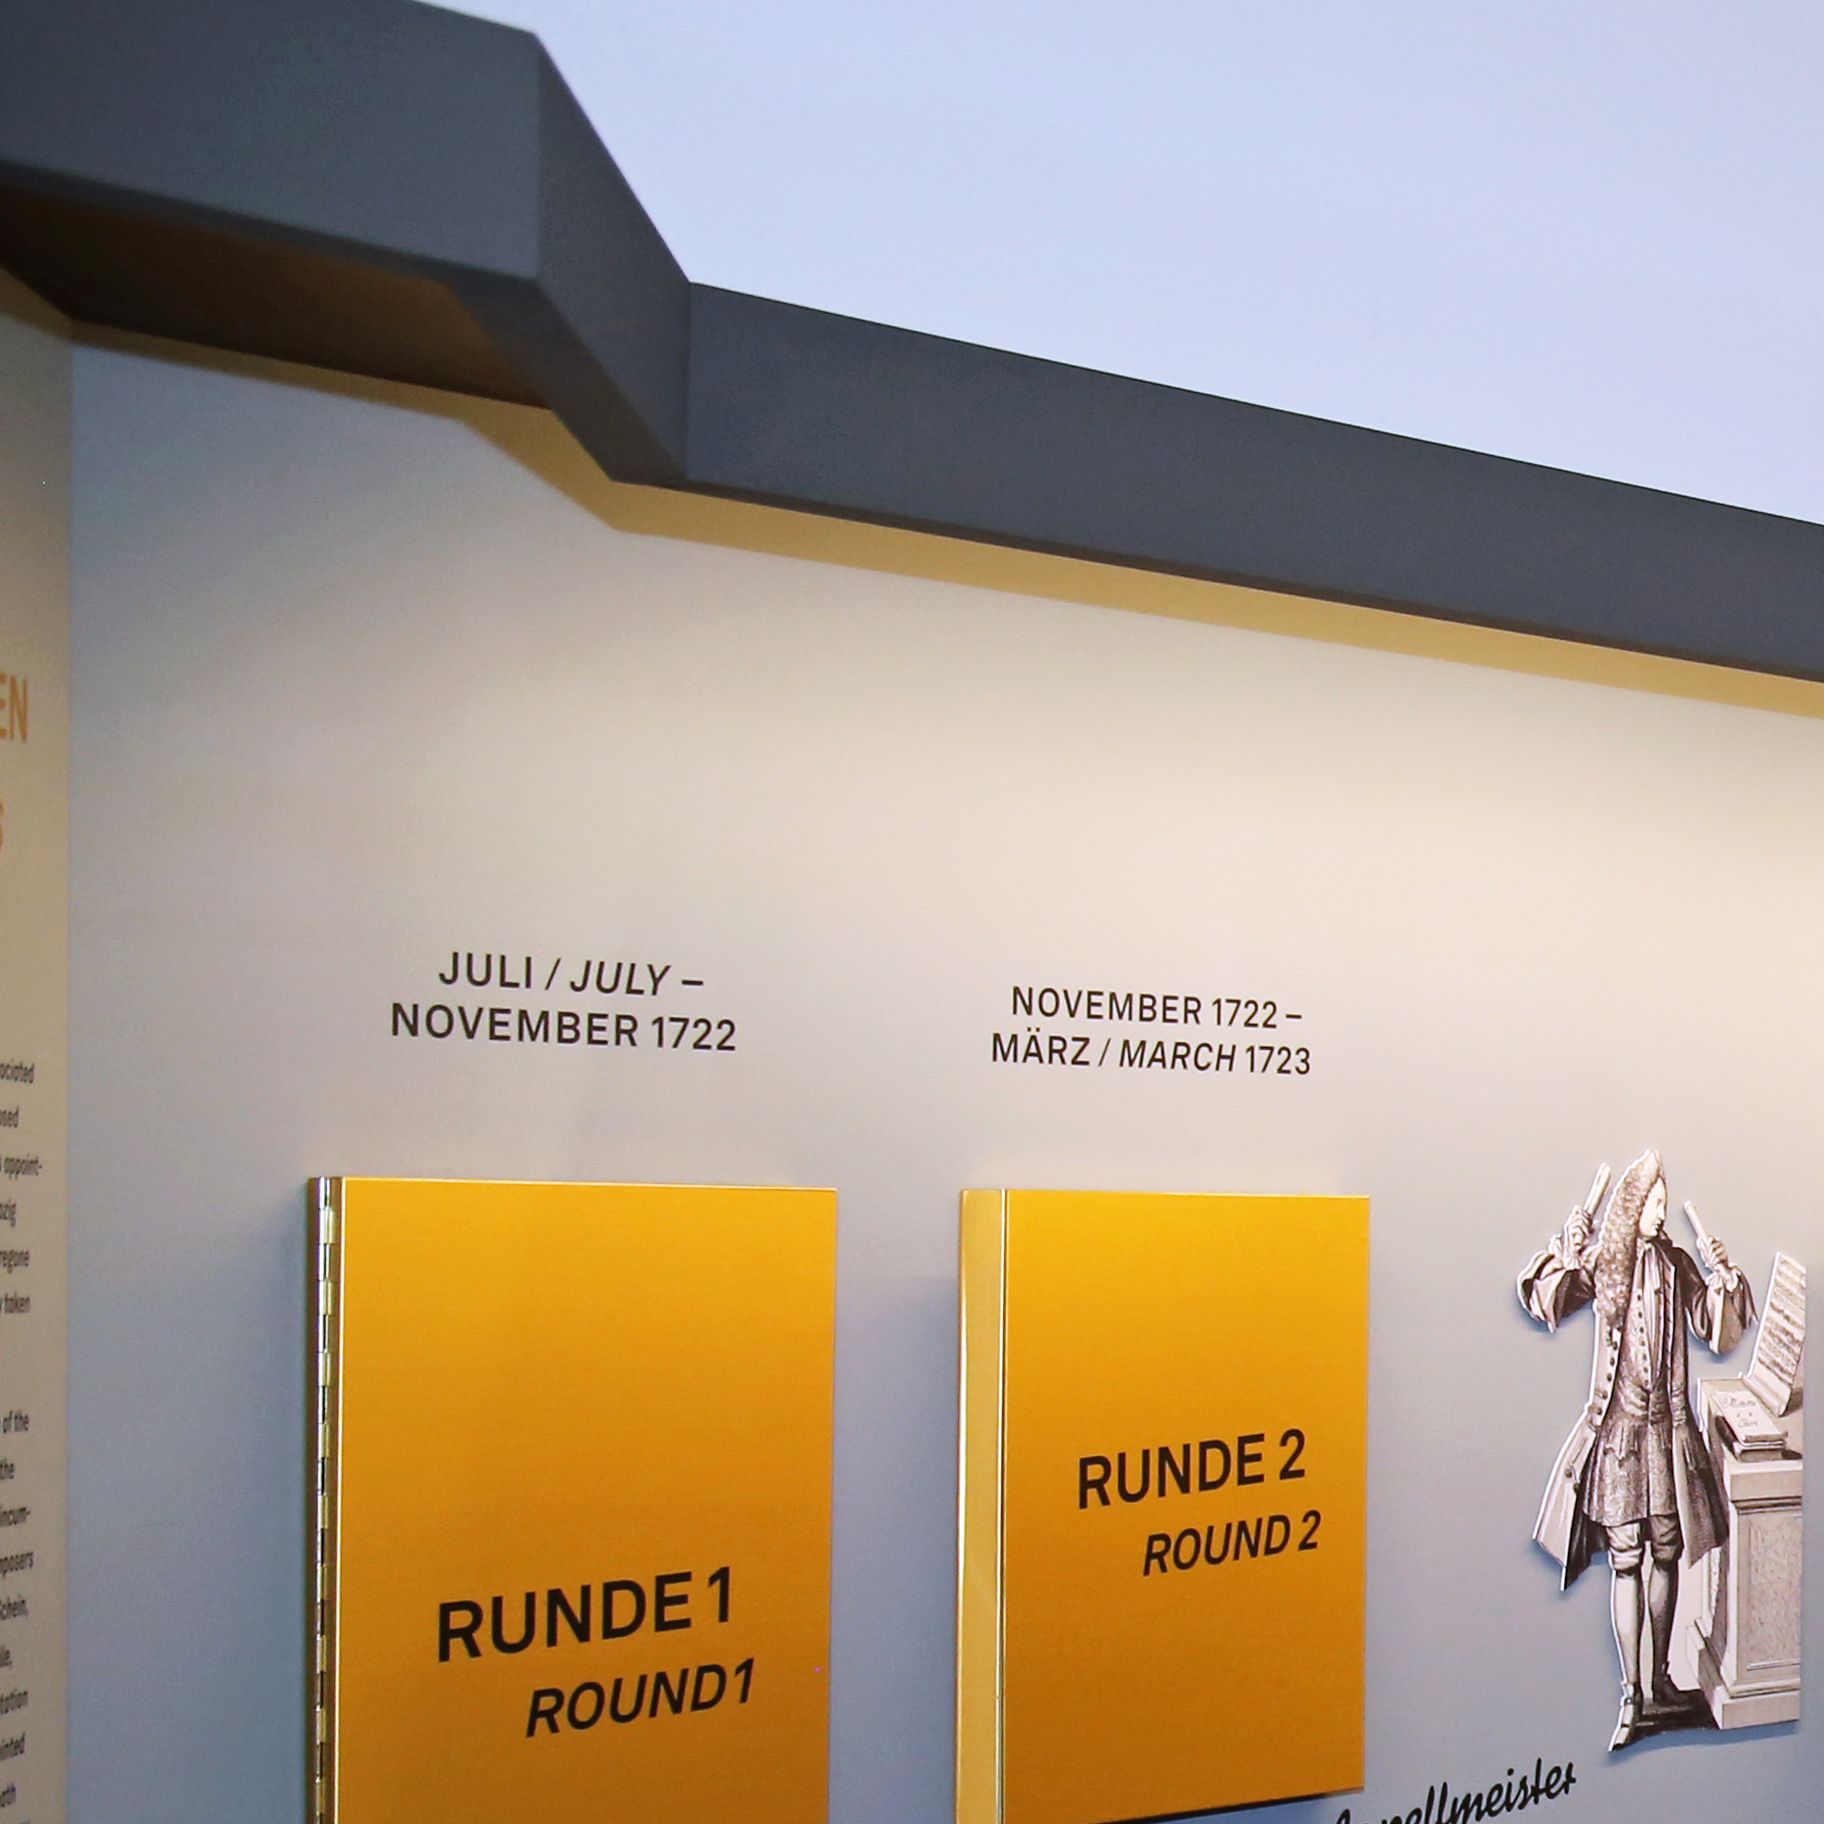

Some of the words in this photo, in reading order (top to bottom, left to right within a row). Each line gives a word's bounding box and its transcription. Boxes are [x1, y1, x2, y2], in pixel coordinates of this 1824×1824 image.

[439, 951, 532, 990] JULI
[569, 959, 671, 997] JULY
[391, 1003, 639, 1047] NOVEMBER
[652, 1017, 736, 1051] 1722
[1012, 986, 1201, 1025] NOVEMBER
[1212, 998, 1277, 1028] 1722
[991, 1028, 1090, 1066] MÄRZ
[1119, 1039, 1236, 1073] MARCH
[1245, 1046, 1311, 1075] 1723
[1079, 1433, 1266, 1509] RUNDE
[1279, 1428, 1307, 1479] 2
[1143, 1515, 1291, 1576] ROUND
[1298, 1510, 1322, 1550] 2
[437, 1572, 692, 1662] RUNDE
[709, 1566, 731, 1623] 1
[525, 1664, 727, 1738] ROUND
[734, 1658, 755, 1704] 1
